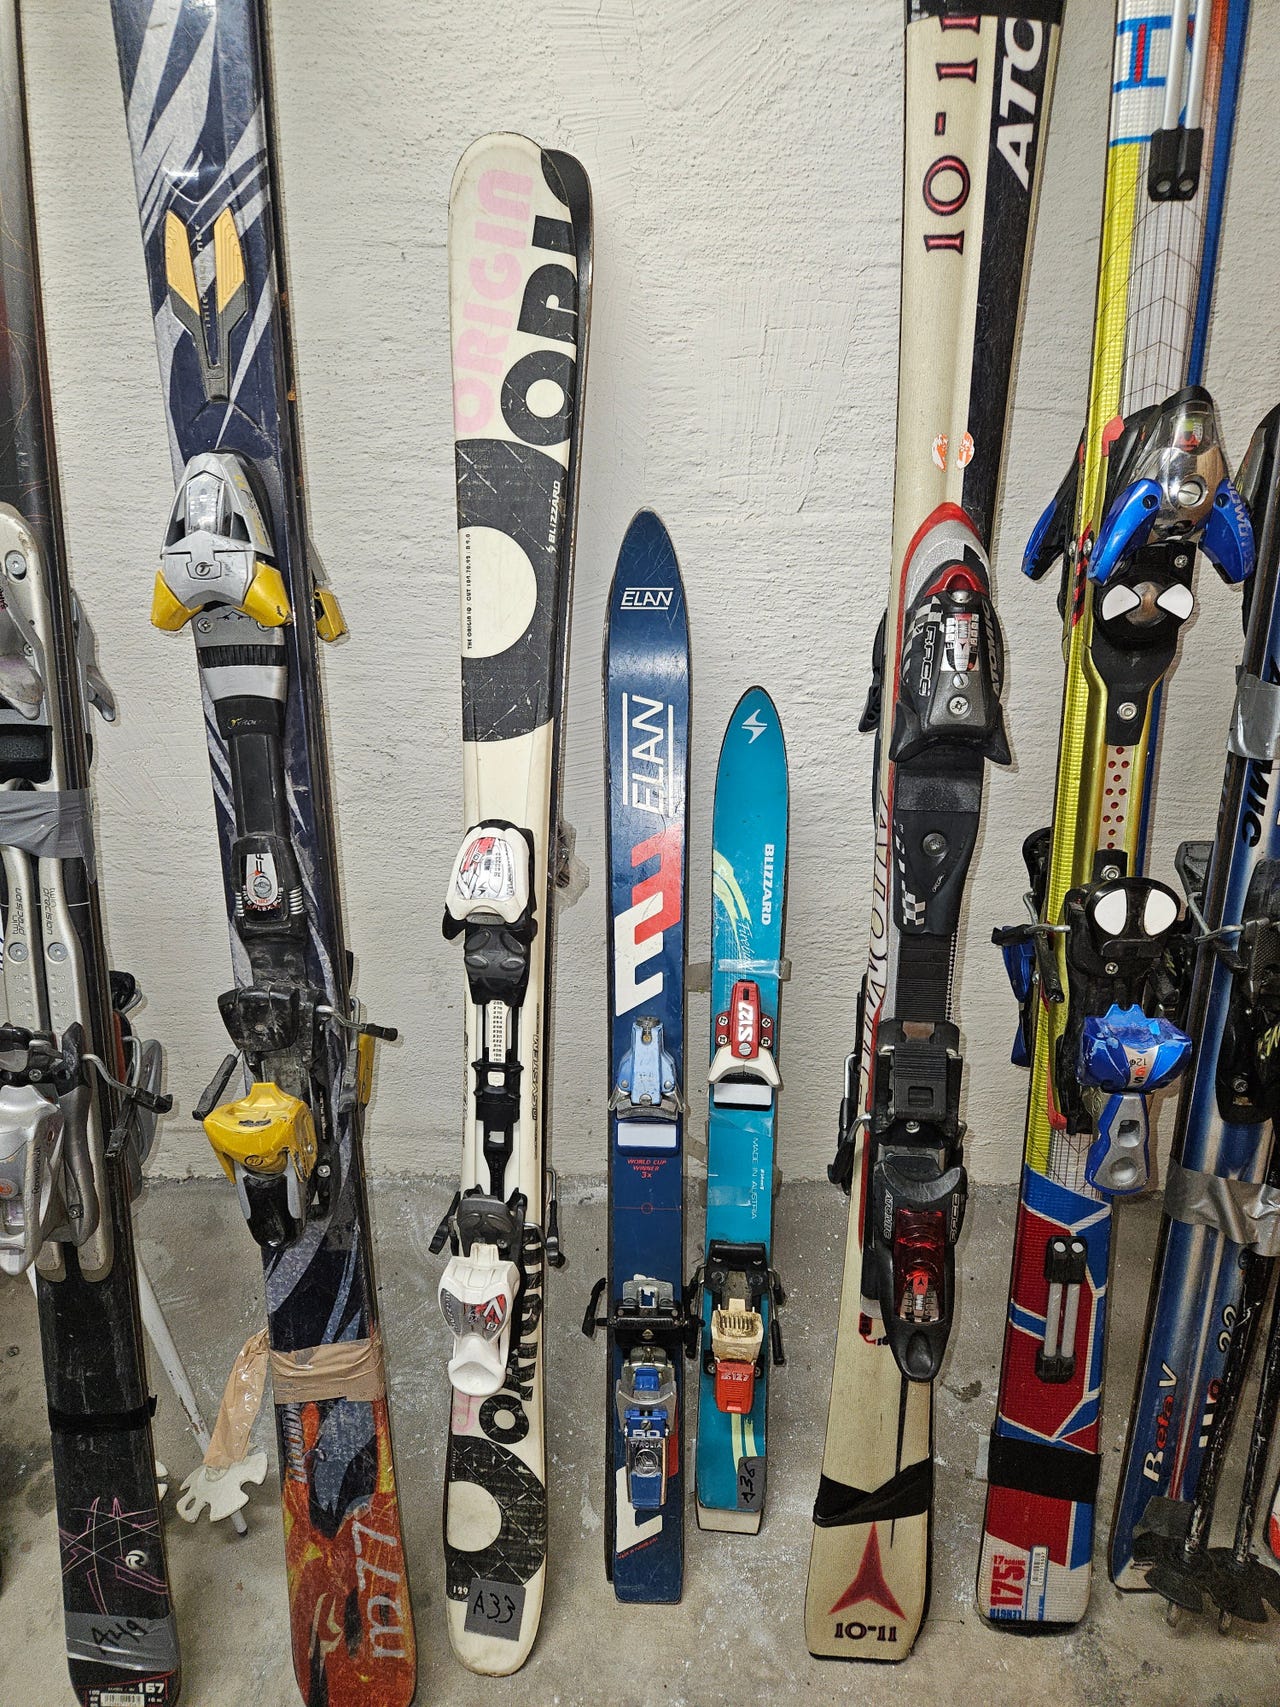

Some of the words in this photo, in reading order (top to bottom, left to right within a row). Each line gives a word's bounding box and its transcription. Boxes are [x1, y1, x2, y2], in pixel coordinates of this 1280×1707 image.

[454, 169, 534, 433] ORIGIN
[548, 480, 561, 545] BLIZZARD
[620, 590, 673, 607] ELAN
[981, 598, 1000, 698] ATOMIC
[632, 694, 665, 815] ELAN
[760, 843, 775, 926] BLIZZARD
[15, 887, 26, 936] precision
[42, 887, 54, 935] precision
[883, 1189, 894, 1239] ATOMIC
[1157, 1362, 1180, 1390] V
[1143, 1395, 1175, 1482] Beta
[453, 1585, 469, 1595] 129
[473, 1590, 516, 1623] A33
[989, 1565, 1026, 1606] 175
[834, 1621, 897, 1643] 10-11
[989, 1608, 1022, 1620] LENGTH
[138, 1682, 165, 1694] 167
